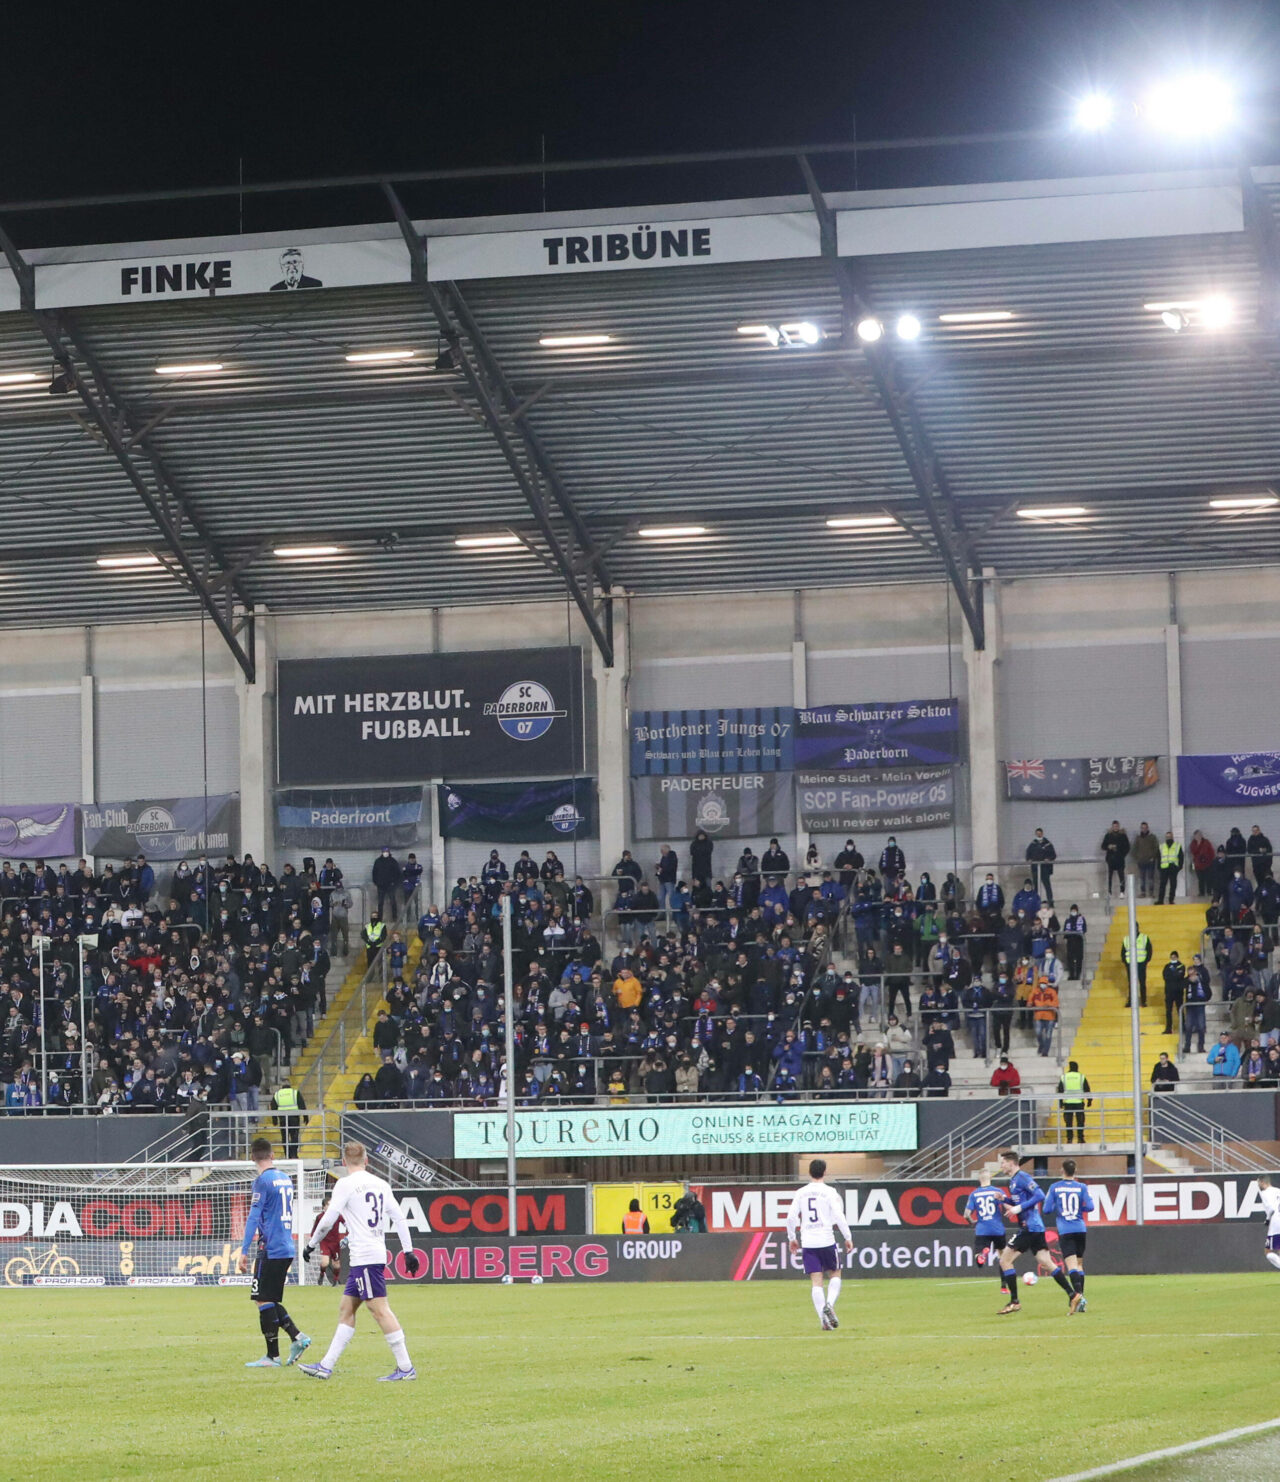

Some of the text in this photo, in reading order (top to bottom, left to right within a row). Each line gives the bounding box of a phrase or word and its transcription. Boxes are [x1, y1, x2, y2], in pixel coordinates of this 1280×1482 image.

[121, 260, 232, 296] FINKE
[543, 224, 711, 266] TRIBÜNE
[519, 686, 531, 698] SC
[293, 689, 471, 715] MIT HERZBLUT.
[483, 701, 548, 715] PADERBORN
[799, 711, 832, 725] Blau
[835, 709, 904, 723] Schwarzer
[361, 717, 471, 741] FUßBALL.
[517, 721, 532, 734] 07
[634, 719, 791, 743] Borchener Jungs 07
[681, 750, 696, 759] und
[844, 747, 909, 763] Paderborn
[660, 776, 765, 792] PADERFEUER
[799, 774, 835, 785] Meine
[838, 774, 871, 784] Stadt
[882, 772, 912, 783] Mein
[915, 768, 951, 780] Verein
[804, 784, 947, 810] SCP Fan-Power 05
[83, 808, 129, 828] Fan-Club
[150, 811, 159, 821] SC
[311, 809, 391, 825] Paderfront
[805, 810, 951, 829] You'll never walk alone
[126, 822, 170, 833] PADERBORN
[149, 838, 159, 847] 07
[691, 1110, 880, 1128] ONLINE-MAGAZIN FÜR
[692, 1127, 880, 1144] GENUSS & ELEKTROMOBILITÄT
[381, 1144, 434, 1182] PB SC 1907
[364, 1191, 384, 1228] 31
[652, 1193, 671, 1210] 13
[807, 1197, 819, 1223] 5
[976, 1195, 996, 1217] 36
[1058, 1192, 1080, 1217] 10
[622, 1239, 683, 1260] GROUP
[44, 1277, 105, 1286] PROFI-CAR
[137, 1277, 195, 1286] PROFI-CAR
